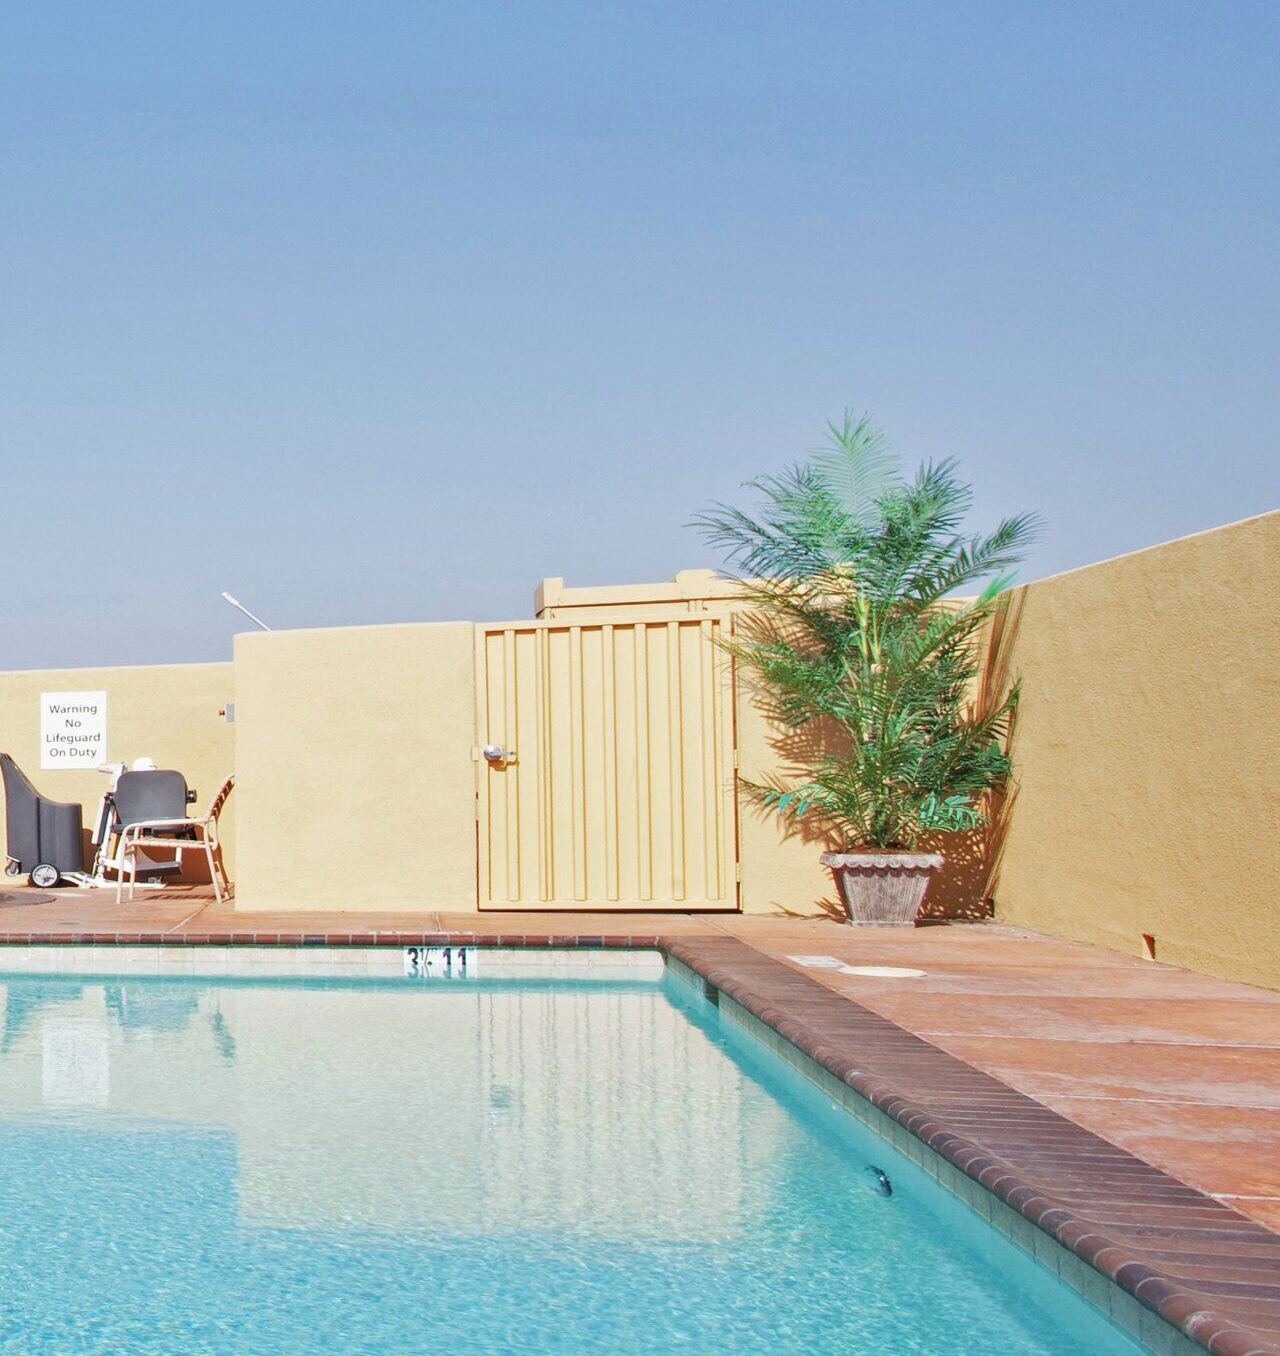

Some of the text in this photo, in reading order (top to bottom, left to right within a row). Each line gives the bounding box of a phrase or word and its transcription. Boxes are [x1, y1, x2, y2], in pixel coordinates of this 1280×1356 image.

[49, 704, 97, 715] Warning
[65, 719, 82, 728] No
[46, 733, 101, 744] Lifeguard
[49, 748, 97, 758] On Duty
